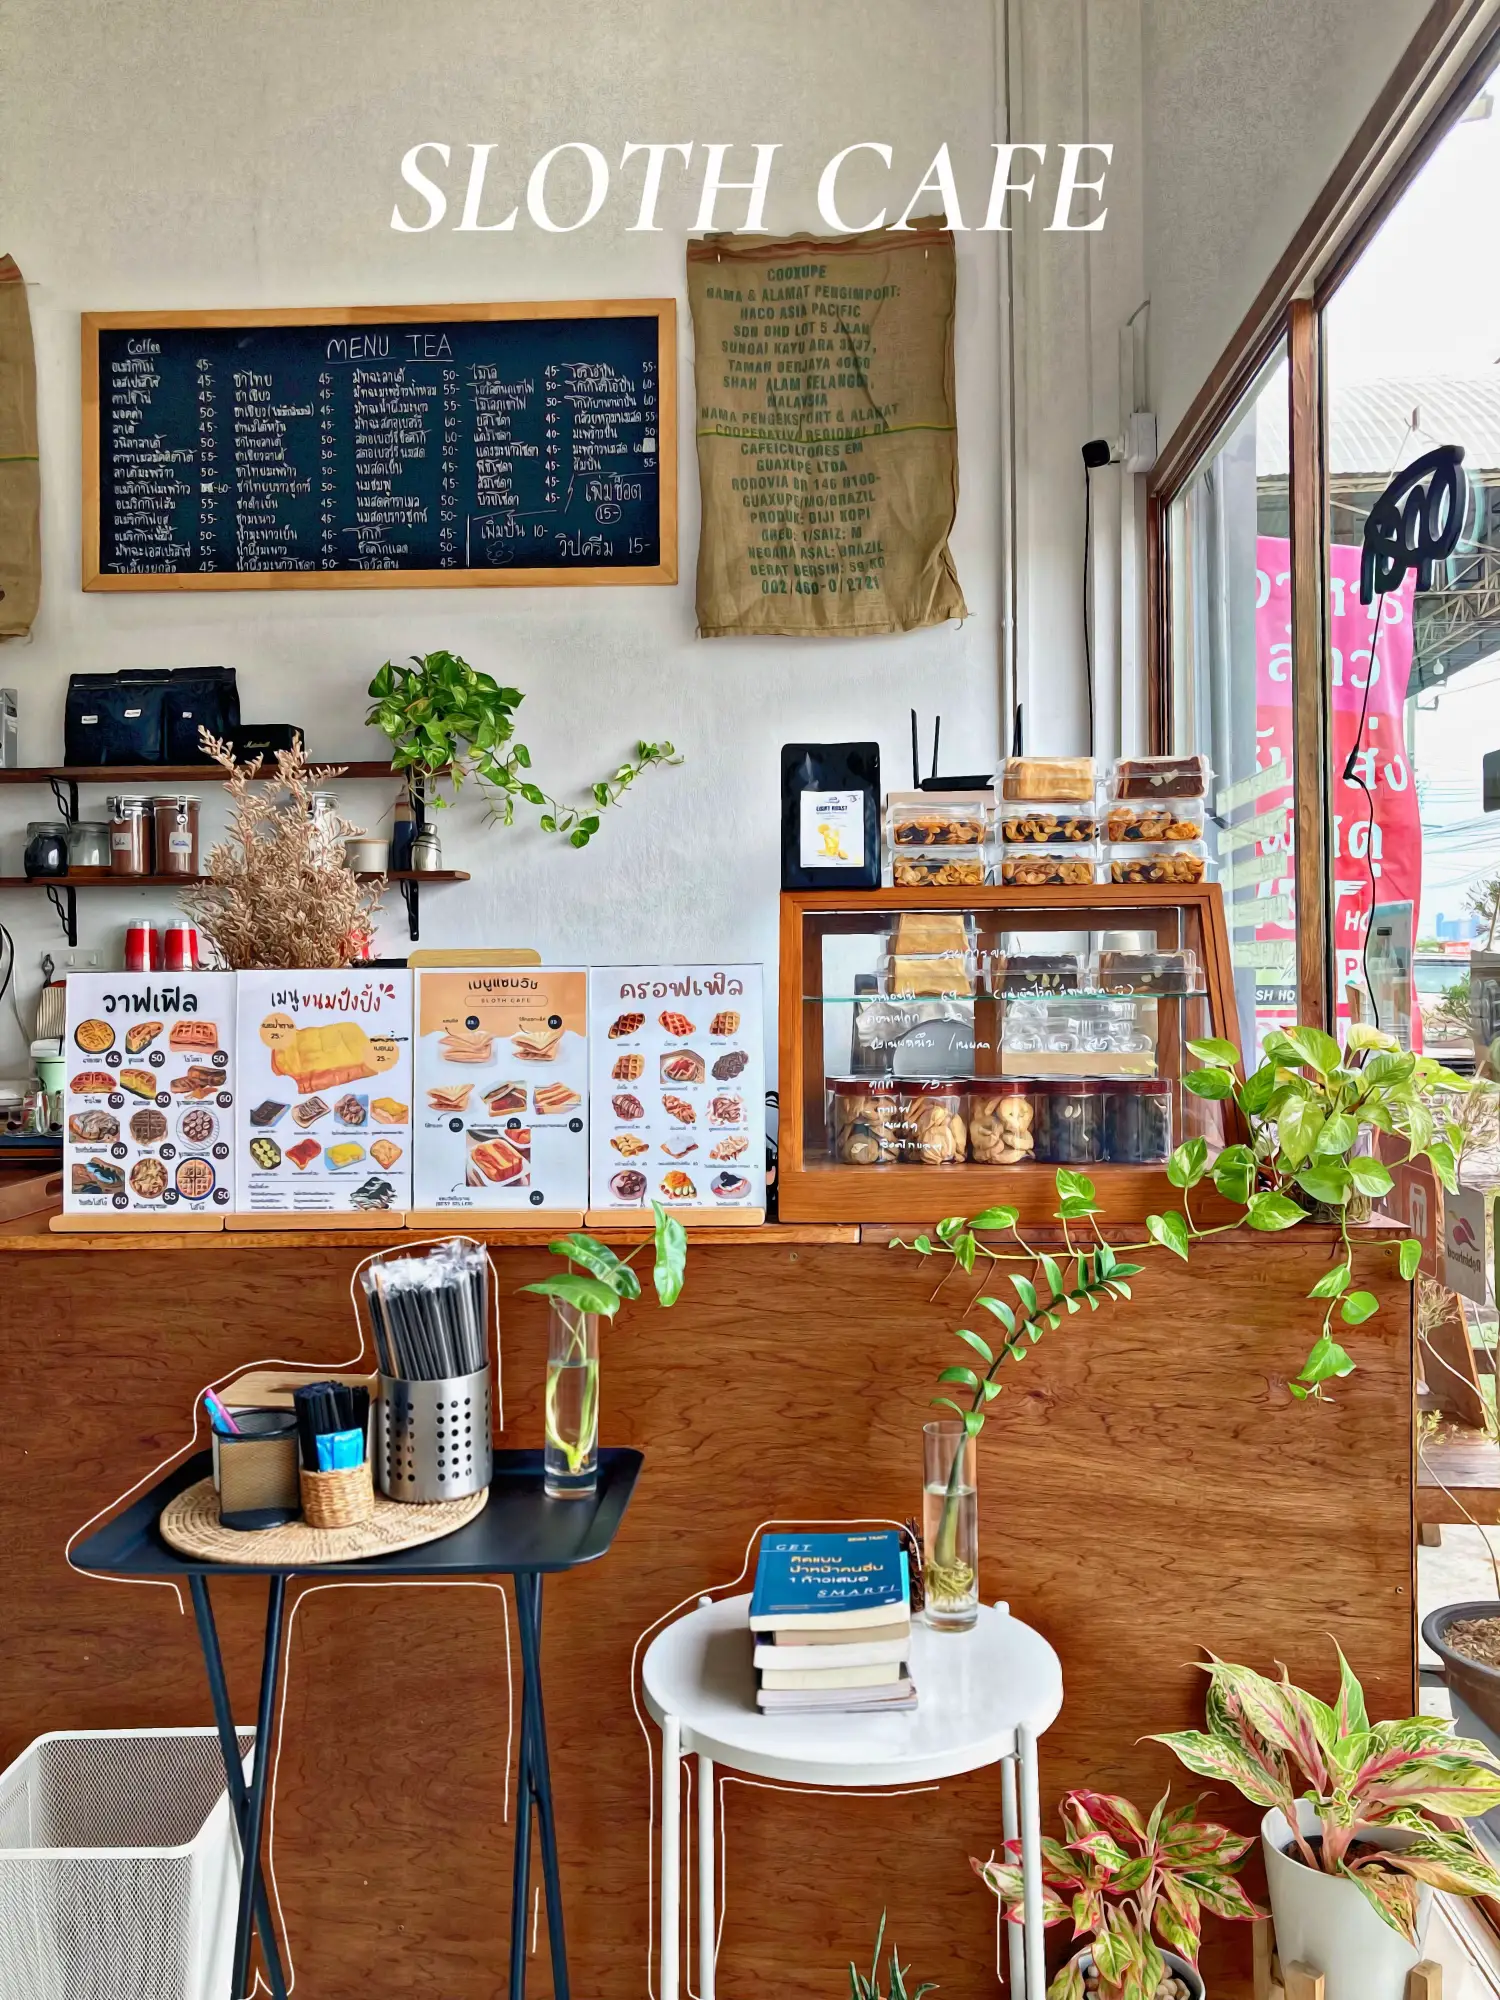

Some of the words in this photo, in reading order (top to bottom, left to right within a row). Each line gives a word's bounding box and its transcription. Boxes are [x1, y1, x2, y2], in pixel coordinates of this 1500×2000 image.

[762, 285, 810, 301] ALAMAT
[780, 305, 807, 319] ASIA
[812, 303, 861, 318] PACIFIC
[795, 322, 814, 336] LOT
[820, 322, 828, 334] 5
[128, 339, 160, 352] Coffee
[327, 334, 390, 360] MENU
[405, 334, 453, 357] TEA
[774, 341, 805, 354] KAYU
[728, 359, 772, 373] TAMAN
[723, 376, 757, 390] SHAH
[766, 377, 800, 392] ALAM
[767, 394, 828, 408] MALAYSIA
[701, 407, 736, 422] NAMA
[845, 442, 863, 455] EM
[817, 461, 848, 473] LTDA
[813, 478, 837, 491] 146
[600, 507, 618, 520] 15-
[534, 525, 548, 537] 10-
[555, 529, 613, 557] วิปครีม
[629, 536, 650, 554] 15-
[800, 546, 835, 560] ASAL:
[620, 972, 743, 999] ครอฟเฟิล
[102, 986, 198, 1013] วาฟเฟิล
[107, 1055, 119, 1063] 45
[151, 1055, 163, 1063] 50
[213, 1055, 225, 1064] 50
[111, 1096, 122, 1104] 50
[157, 1095, 169, 1104] 50
[220, 1095, 231, 1103] 60
[113, 1146, 124, 1155] 60
[215, 1145, 228, 1154] 60
[115, 1196, 127, 1205] 60
[164, 1192, 176, 1200] 55
